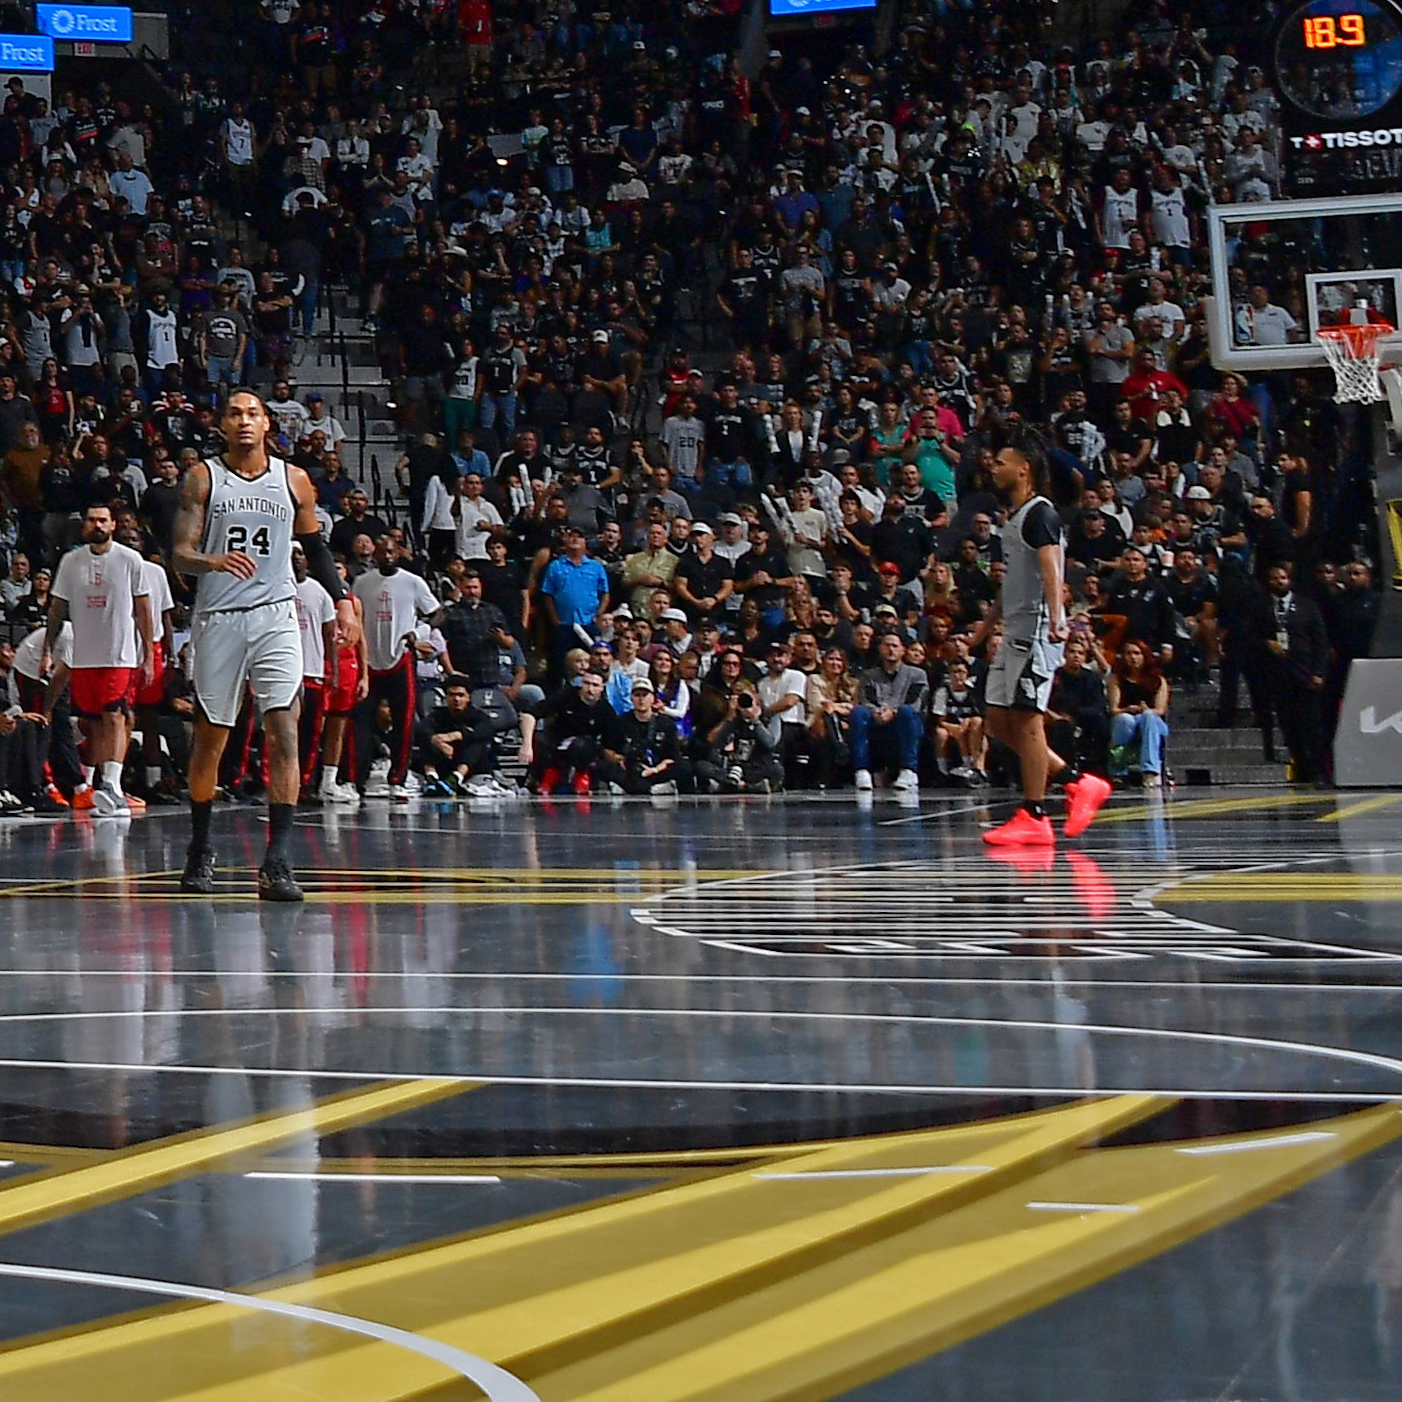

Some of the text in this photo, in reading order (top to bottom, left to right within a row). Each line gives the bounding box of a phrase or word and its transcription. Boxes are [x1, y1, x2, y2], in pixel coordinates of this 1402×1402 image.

[76, 14, 118, 33] Frost
[1303, 14, 1366, 48] 18.9
[0, 42, 45, 62] Frost
[1321, 128, 1402, 149] TISSOT
[212, 498, 288, 522] SAN ANTONIO
[225, 524, 271, 557] 24
